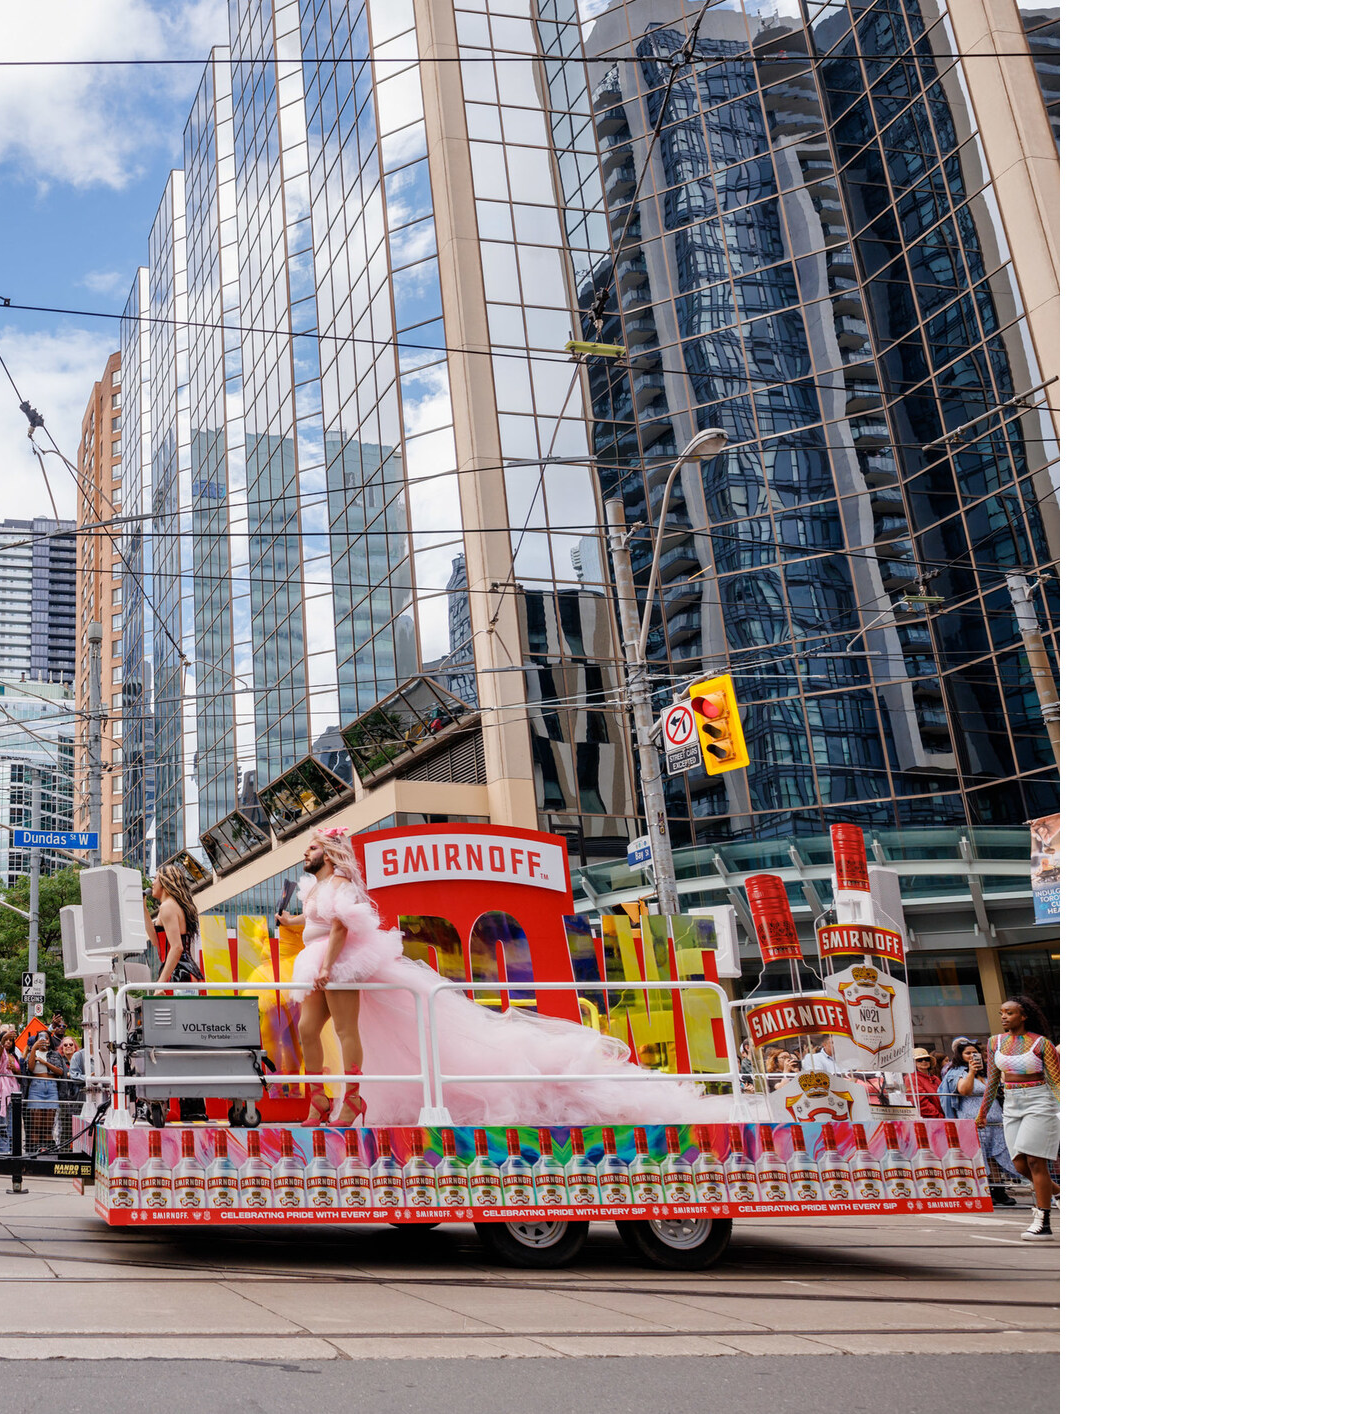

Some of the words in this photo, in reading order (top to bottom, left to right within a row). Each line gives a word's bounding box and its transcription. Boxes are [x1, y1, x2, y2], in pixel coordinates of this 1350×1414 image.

[669, 751, 686, 762] STREET
[686, 747, 698, 757] CARS
[673, 757, 696, 770] EXCEPTED
[23, 831, 67, 845] Dundas
[70, 833, 77, 841] St
[78, 834, 89, 846] W
[382, 843, 541, 877] SMIRNOFF
[635, 851, 644, 861] Bay
[182, 1023, 231, 1032] VOLTstack
[236, 1023, 247, 1032] 5k
[855, 1024, 886, 1034] VODKA
[728, 1173, 756, 1182] SMIRNOFF
[759, 1172, 787, 1181] SMIRNOFF
[790, 1171, 818, 1180] SMIRNOFF
[822, 1170, 850, 1180] SMIRNOFF
[852, 1170, 880, 1180] SMIRNOFF
[884, 1170, 912, 1179] SMIRNOFF
[915, 1169, 943, 1178] SMIRNOFF
[946, 1168, 973, 1178] SMIRNOFF
[208, 1178, 237, 1187] SMIRNOFF
[241, 1178, 270, 1187] SMIRNOFF
[274, 1178, 304, 1187] SMIRNOFF
[307, 1178, 336, 1186] SMIRNOFF
[340, 1177, 369, 1186] SMIRNOFF
[373, 1177, 402, 1186] SMIRNOFF
[406, 1177, 434, 1186] SMIRNOFF
[438, 1177, 468, 1186] SMIRNOFF
[471, 1176, 500, 1186] SMIRNOFF
[504, 1176, 532, 1185] SMIRNOFF
[536, 1176, 564, 1185] SMIRNOFF
[568, 1176, 596, 1184] SMIRNOFF
[600, 1175, 628, 1184] SMIRNOFF
[632, 1174, 660, 1183] SMIRNOFF
[664, 1174, 692, 1182] SMIRNOFF
[696, 1174, 724, 1182] SMIRNOFF
[142, 1178, 170, 1188] SMIRNOFF
[175, 1178, 204, 1188] SMIRNOFF
[738, 1204, 800, 1213] CELEBRATING
[801, 1204, 828, 1212] PRIDE
[882, 1202, 898, 1210] SIP
[221, 1211, 284, 1219] CELEBRATING
[373, 1210, 388, 1218] SIP
[482, 1209, 546, 1217] CELEBRATING
[547, 1208, 574, 1216] PRIDE
[576, 1208, 599, 1216] WITH
[600, 1208, 630, 1216] EVERY
